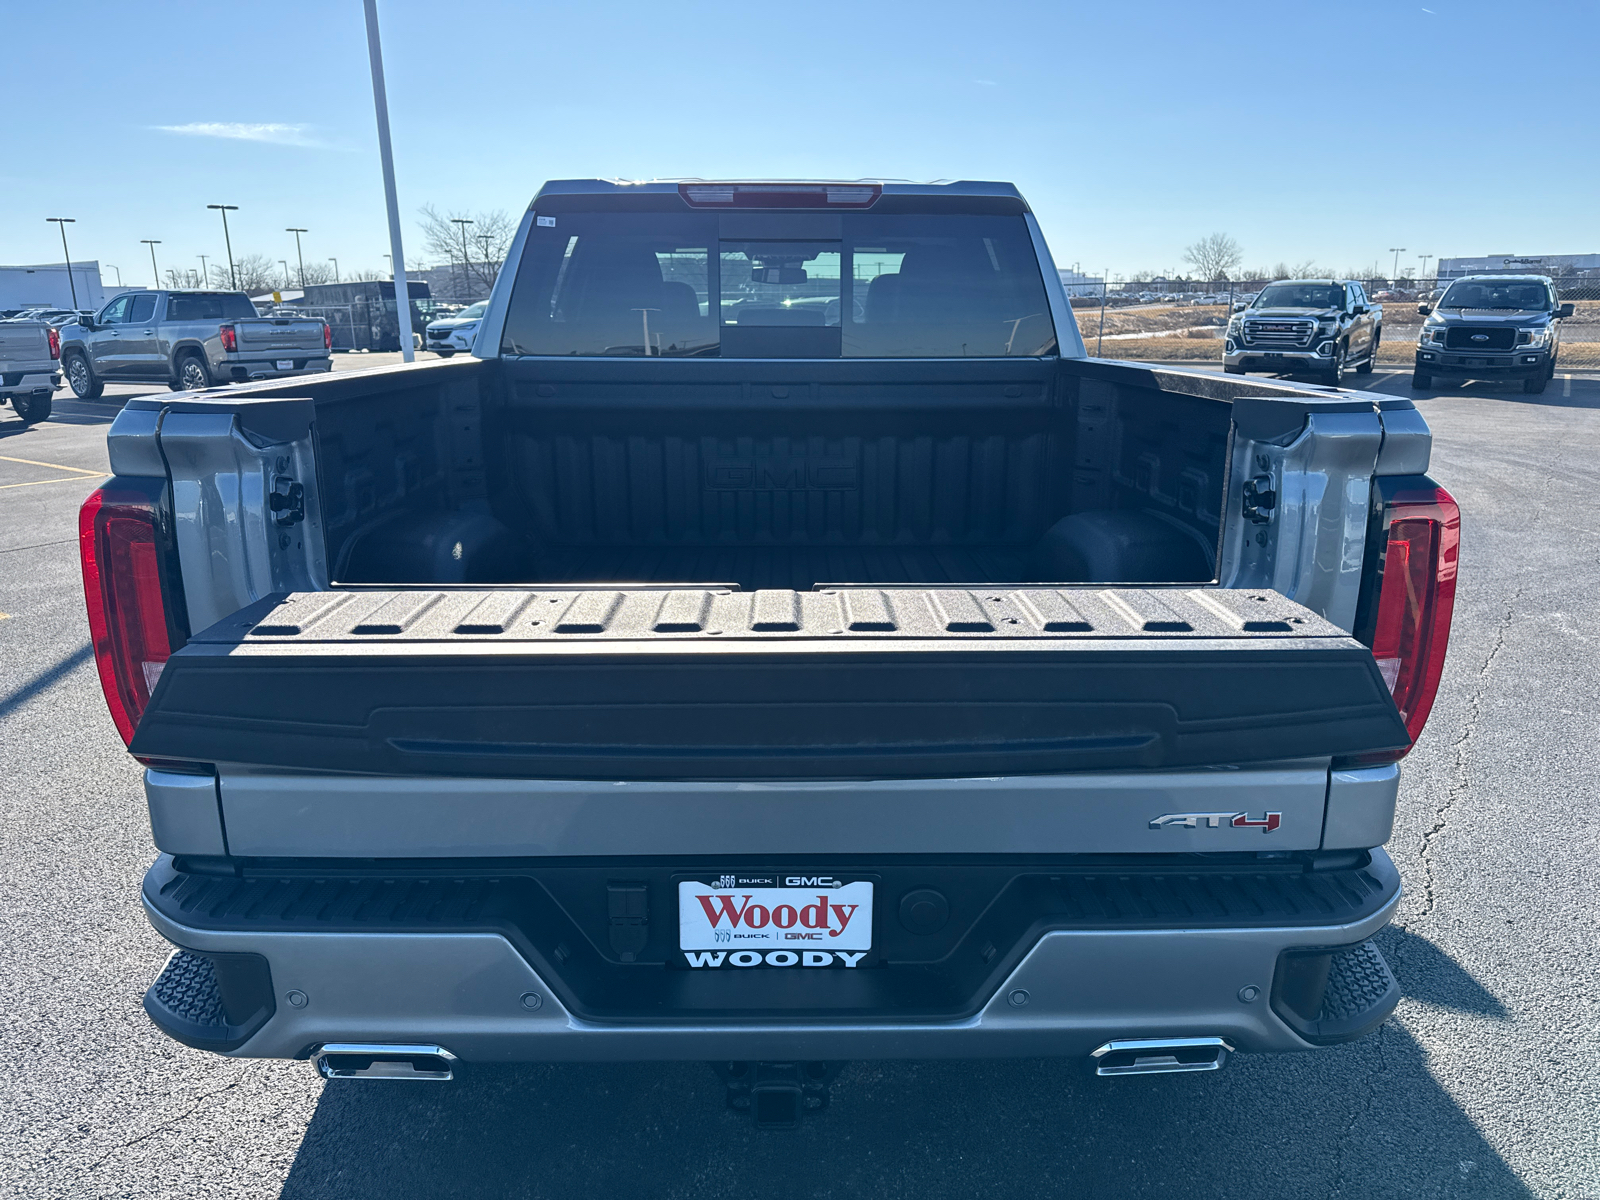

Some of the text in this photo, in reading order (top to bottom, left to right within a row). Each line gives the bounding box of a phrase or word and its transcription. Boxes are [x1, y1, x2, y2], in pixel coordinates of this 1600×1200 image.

[705, 459, 857, 491] GMC
[1149, 811, 1283, 834] AT4
[785, 876, 833, 886] GMC
[695, 895, 859, 937] Woody
[784, 932, 823, 940] GMC
[684, 951, 868, 968] WOODY
